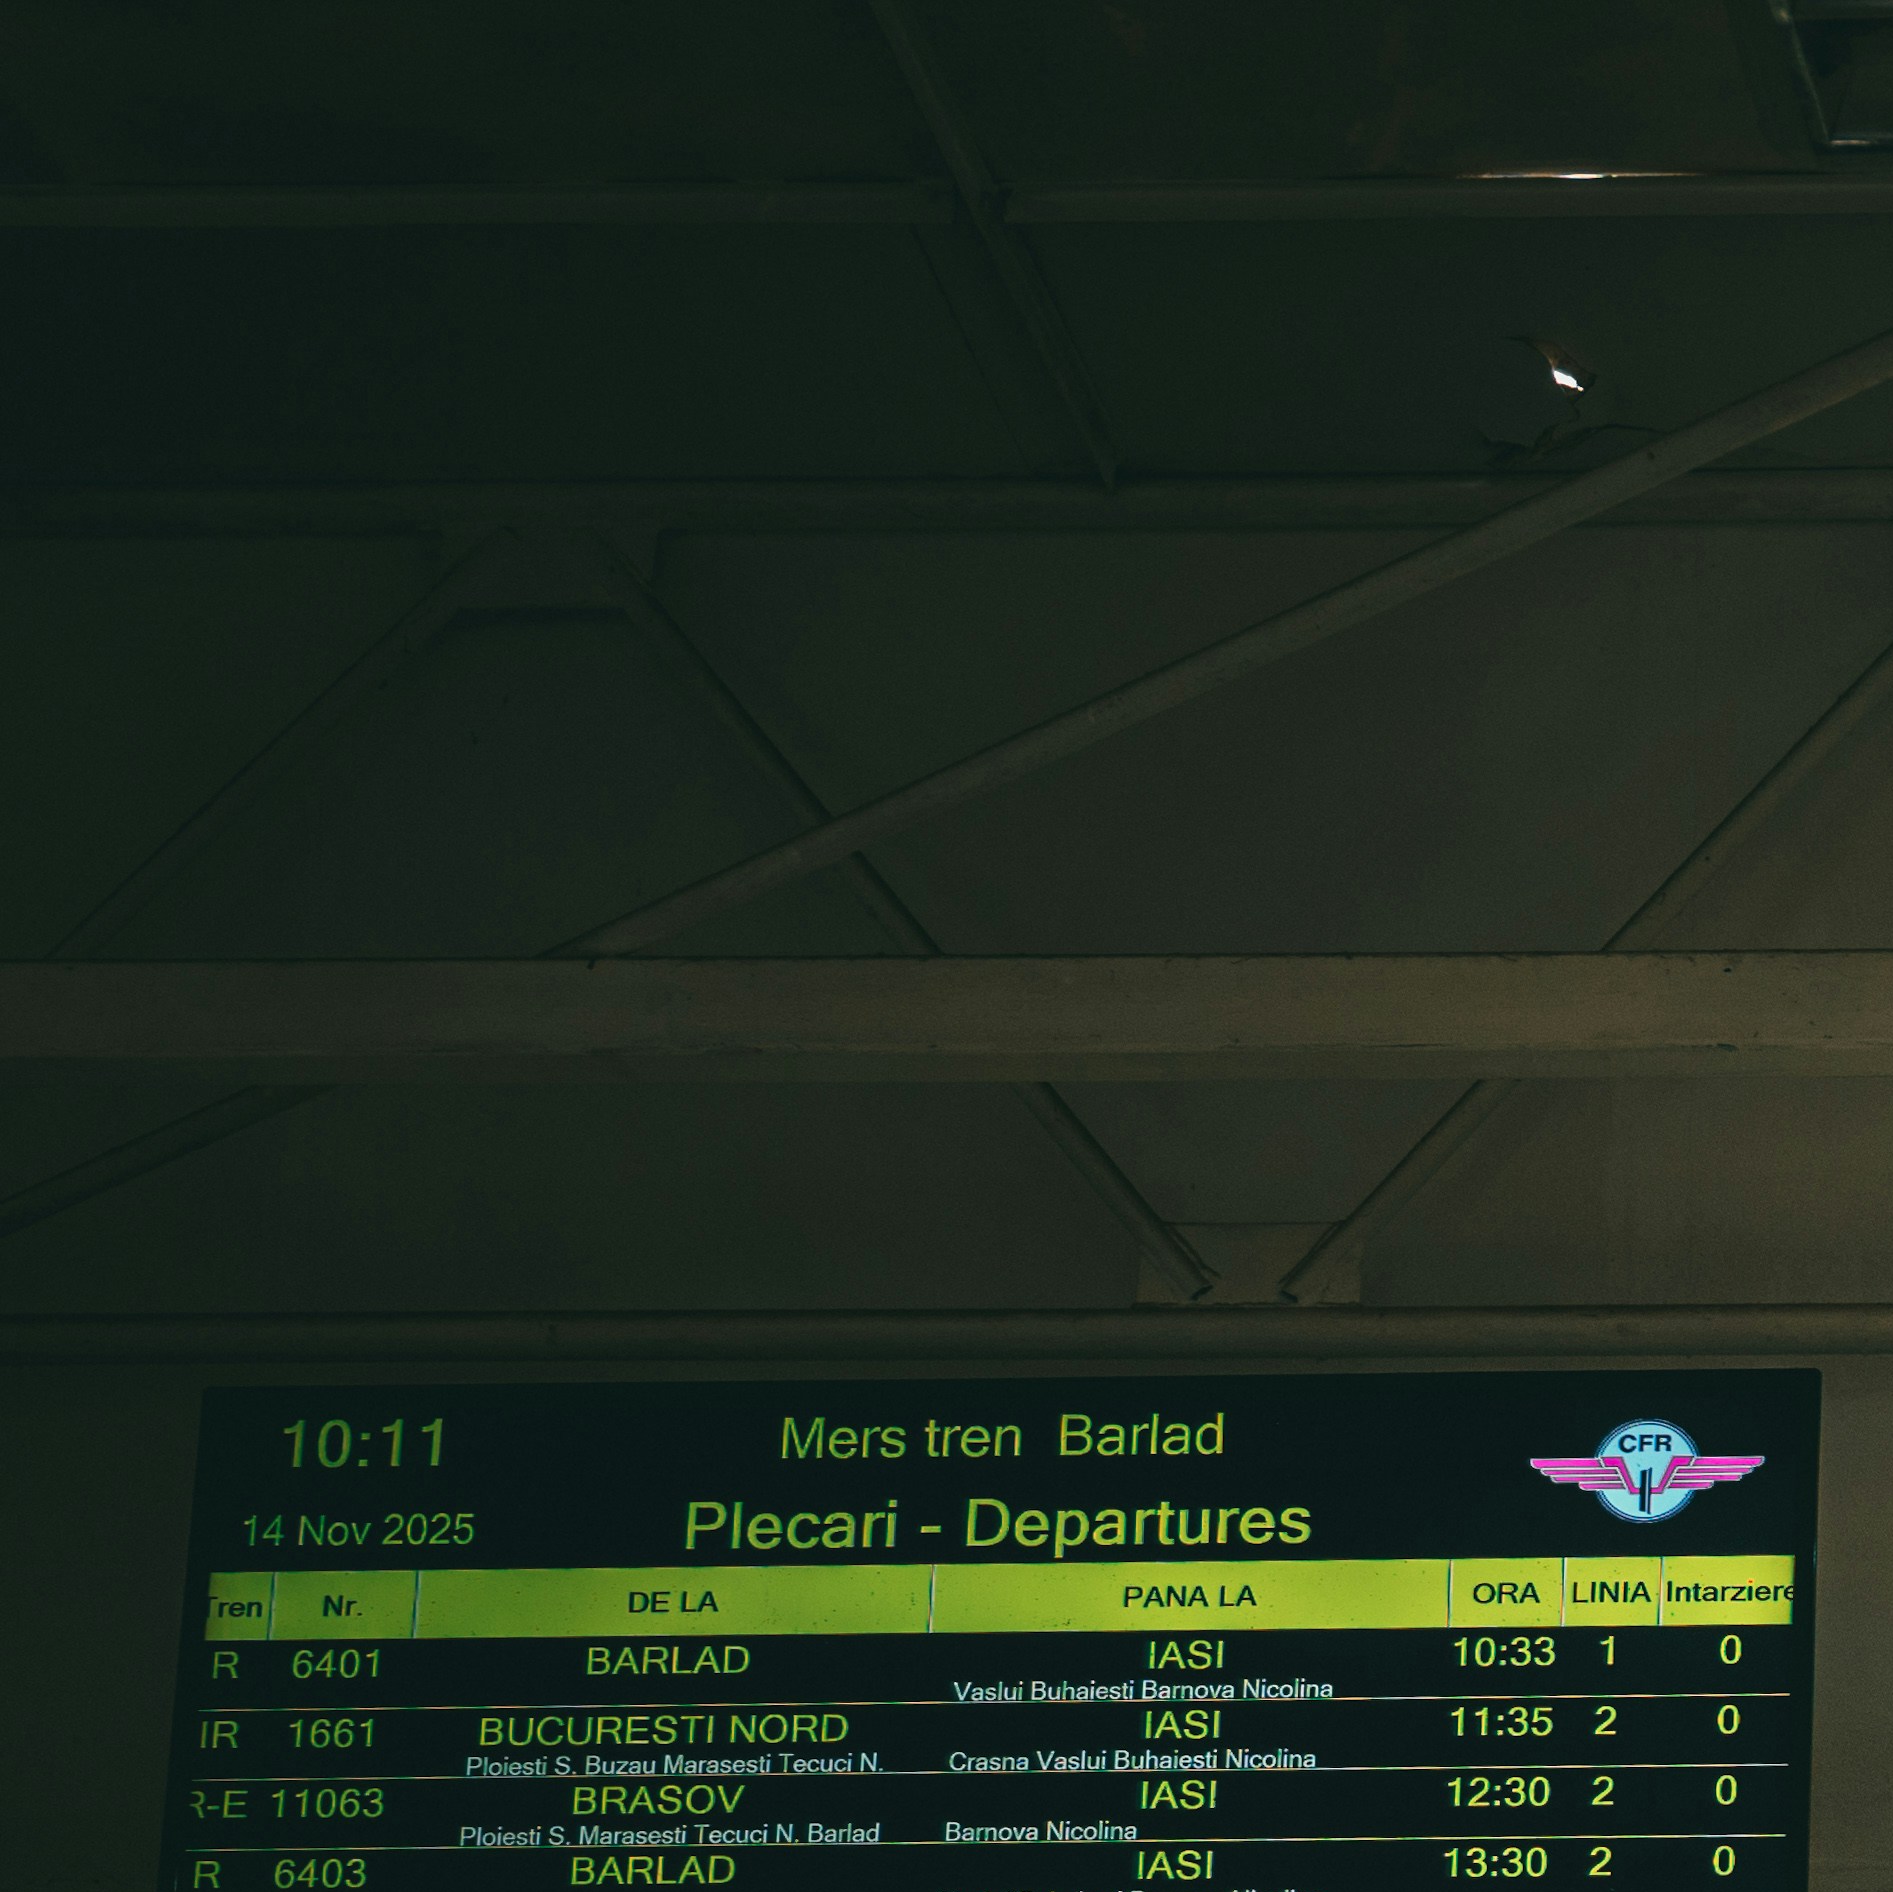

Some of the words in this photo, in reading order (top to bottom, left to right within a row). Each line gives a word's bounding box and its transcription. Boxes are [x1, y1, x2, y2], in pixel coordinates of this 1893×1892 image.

[283, 1418, 443, 1468] 10:11
[781, 1416, 907, 1459] Mers
[924, 1419, 1022, 1458] tren
[1059, 1412, 1225, 1456] Barlad
[1619, 1432, 1673, 1454] CFR
[243, 1514, 284, 1546] 14
[298, 1514, 372, 1547] Nov
[381, 1512, 475, 1545] 2025
[685, 1499, 898, 1550] Plecari
[919, 1524, 943, 1535] -
[965, 1498, 1313, 1558] Departures
[322, 1594, 363, 1617] Nr.
[628, 1591, 671, 1614] DE
[680, 1590, 719, 1613] LA
[1123, 1585, 1209, 1608] PANA
[1219, 1584, 1257, 1607] LA
[1472, 1582, 1541, 1605] ORA
[1572, 1581, 1652, 1604] LINIA
[212, 1651, 239, 1679] R
[292, 1648, 380, 1679] 6401
[586, 1645, 751, 1675] BARLAD
[1149, 1639, 1224, 1670] IASI
[1453, 1636, 1556, 1667] 10:33
[1600, 1635, 1615, 1665] 1
[1719, 1634, 1742, 1665] 0
[953, 1680, 1024, 1702] Vaslui
[1031, 1679, 1135, 1702] Buhaiesti
[1141, 1679, 1235, 1702] Barnova
[1242, 1678, 1333, 1702] Nicolina
[200, 1720, 239, 1749] IR
[289, 1718, 374, 1748] 1661
[479, 1715, 714, 1746] BUCURESTI
[729, 1713, 849, 1744] NORD
[1145, 1709, 1221, 1740] IASI
[1450, 1706, 1554, 1737] 11:35
[1594, 1705, 1617, 1735] 2
[1717, 1704, 1740, 1735] 0
[466, 1755, 548, 1777] Ploiesti
[554, 1755, 578, 1777] S.
[585, 1755, 656, 1777] Buzau
[663, 1753, 772, 1777] Marasesti
[778, 1752, 853, 1777] Tecuci
[860, 1751, 884, 1777] N.
[949, 1751, 1029, 1772] Crasna
[1036, 1749, 1107, 1772] Vaslui
[1114, 1748, 1218, 1772] Buhaiesti
[1225, 1748, 1316, 1772] Nicolina
